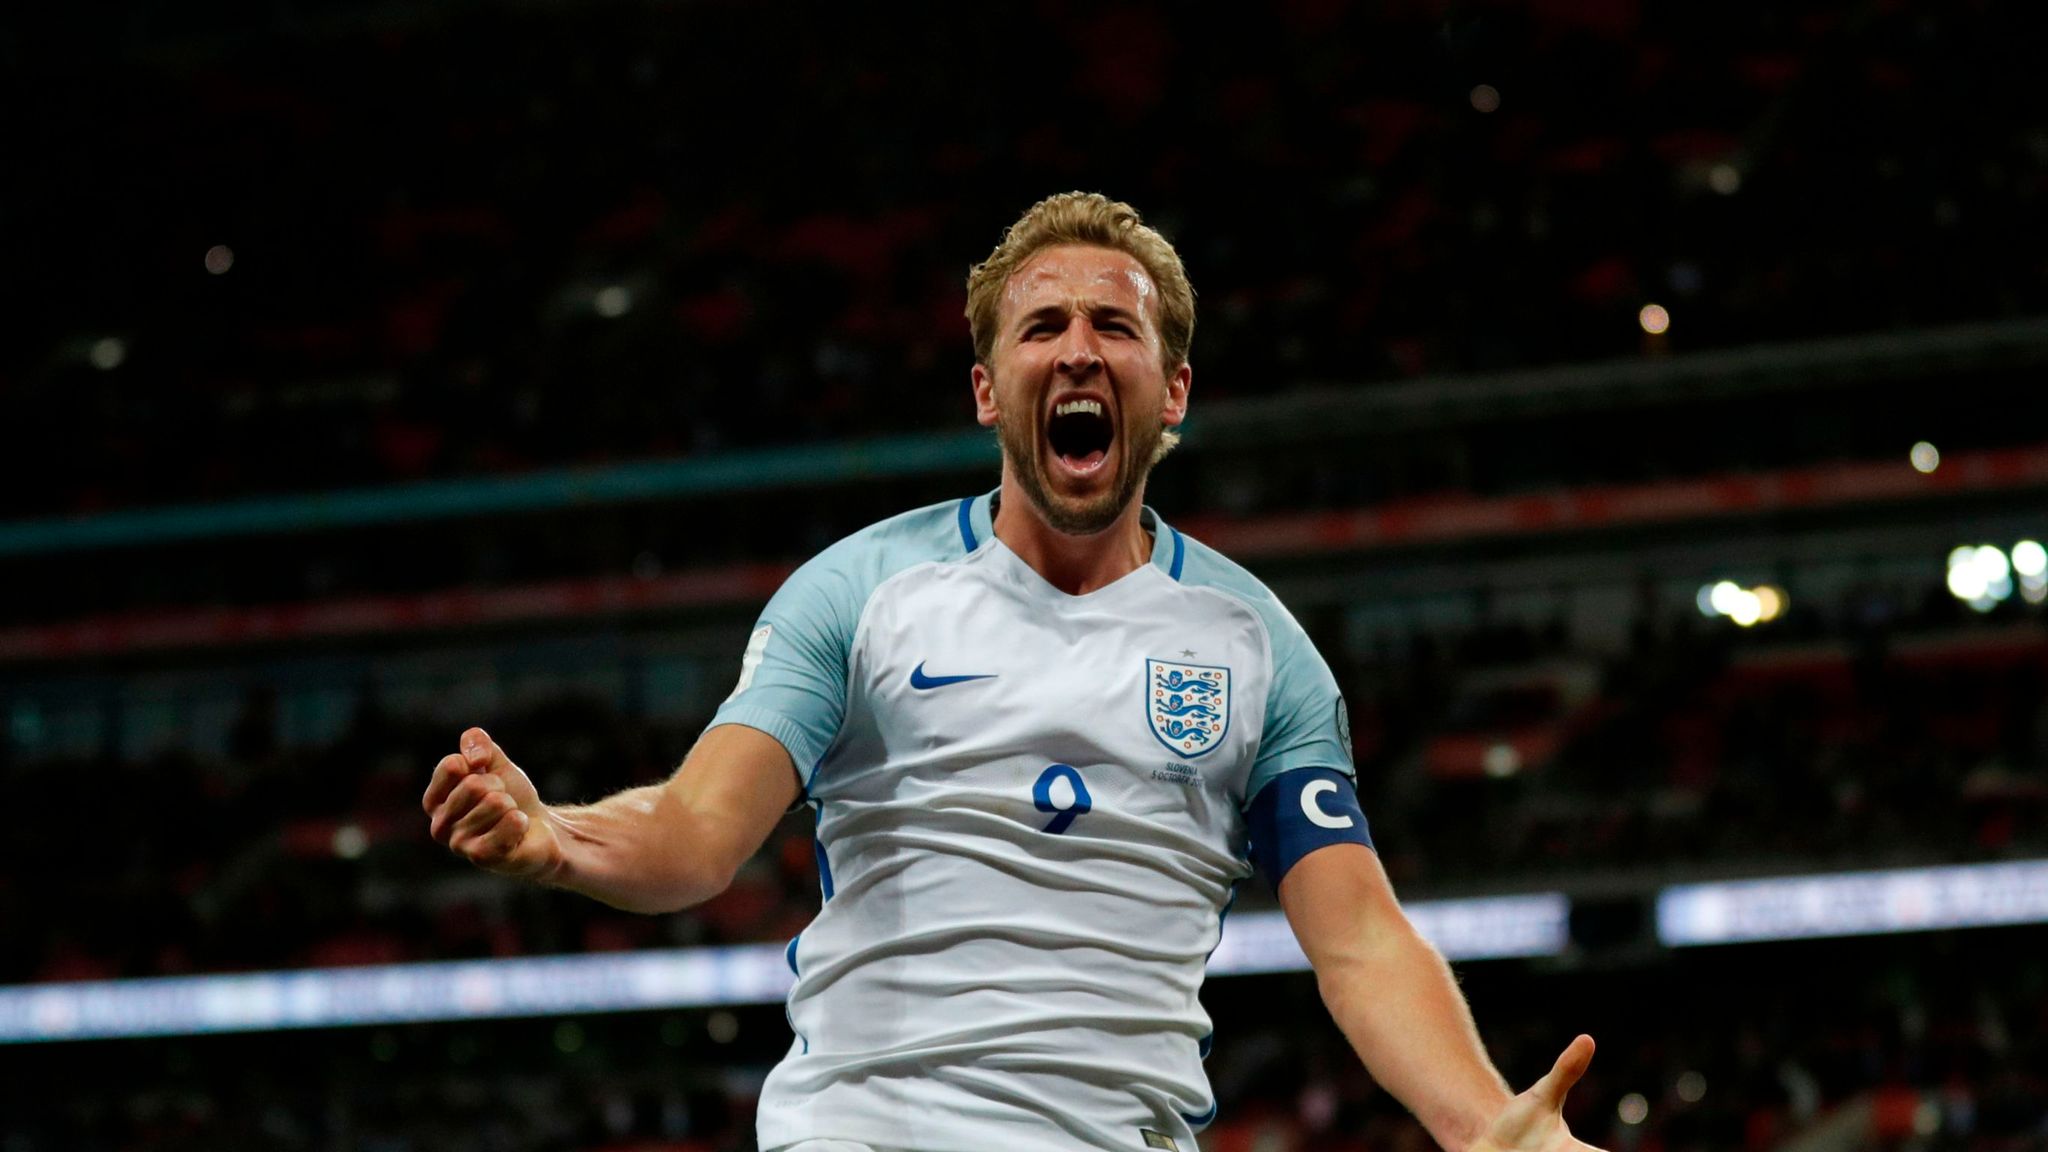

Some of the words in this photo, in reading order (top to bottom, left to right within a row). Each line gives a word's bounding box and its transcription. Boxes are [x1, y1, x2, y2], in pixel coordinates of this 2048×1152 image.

[1151, 769, 1158, 780] 5
[1157, 771, 1191, 785] OCTOBER
[1166, 762, 1198, 776] SLOVENI
[1032, 763, 1092, 835] 9
[1300, 779, 1354, 829] C
